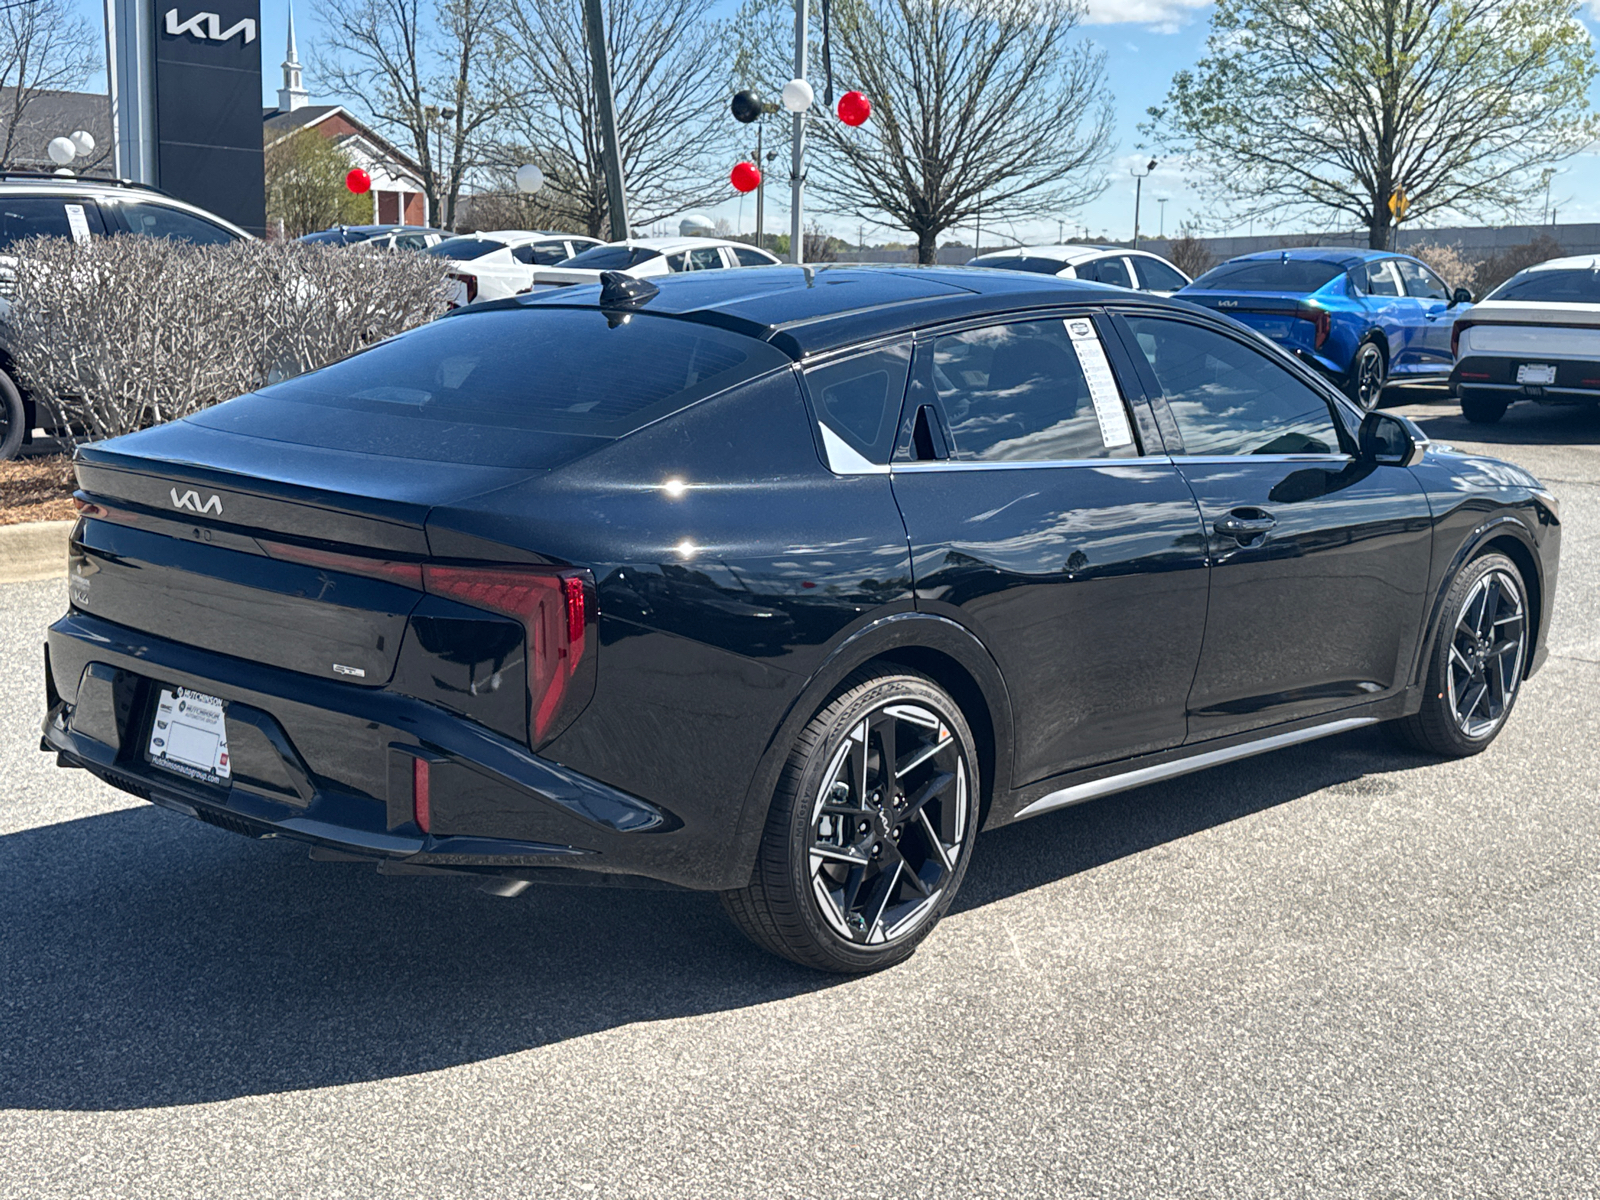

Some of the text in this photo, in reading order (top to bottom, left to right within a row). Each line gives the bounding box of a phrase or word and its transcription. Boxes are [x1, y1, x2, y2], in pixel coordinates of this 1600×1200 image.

[165, 8, 256, 44] KIA
[170, 487, 223, 516] KIA
[184, 689, 223, 707] HUTCHINSON
[186, 704, 221, 720] HUTCHINSON
